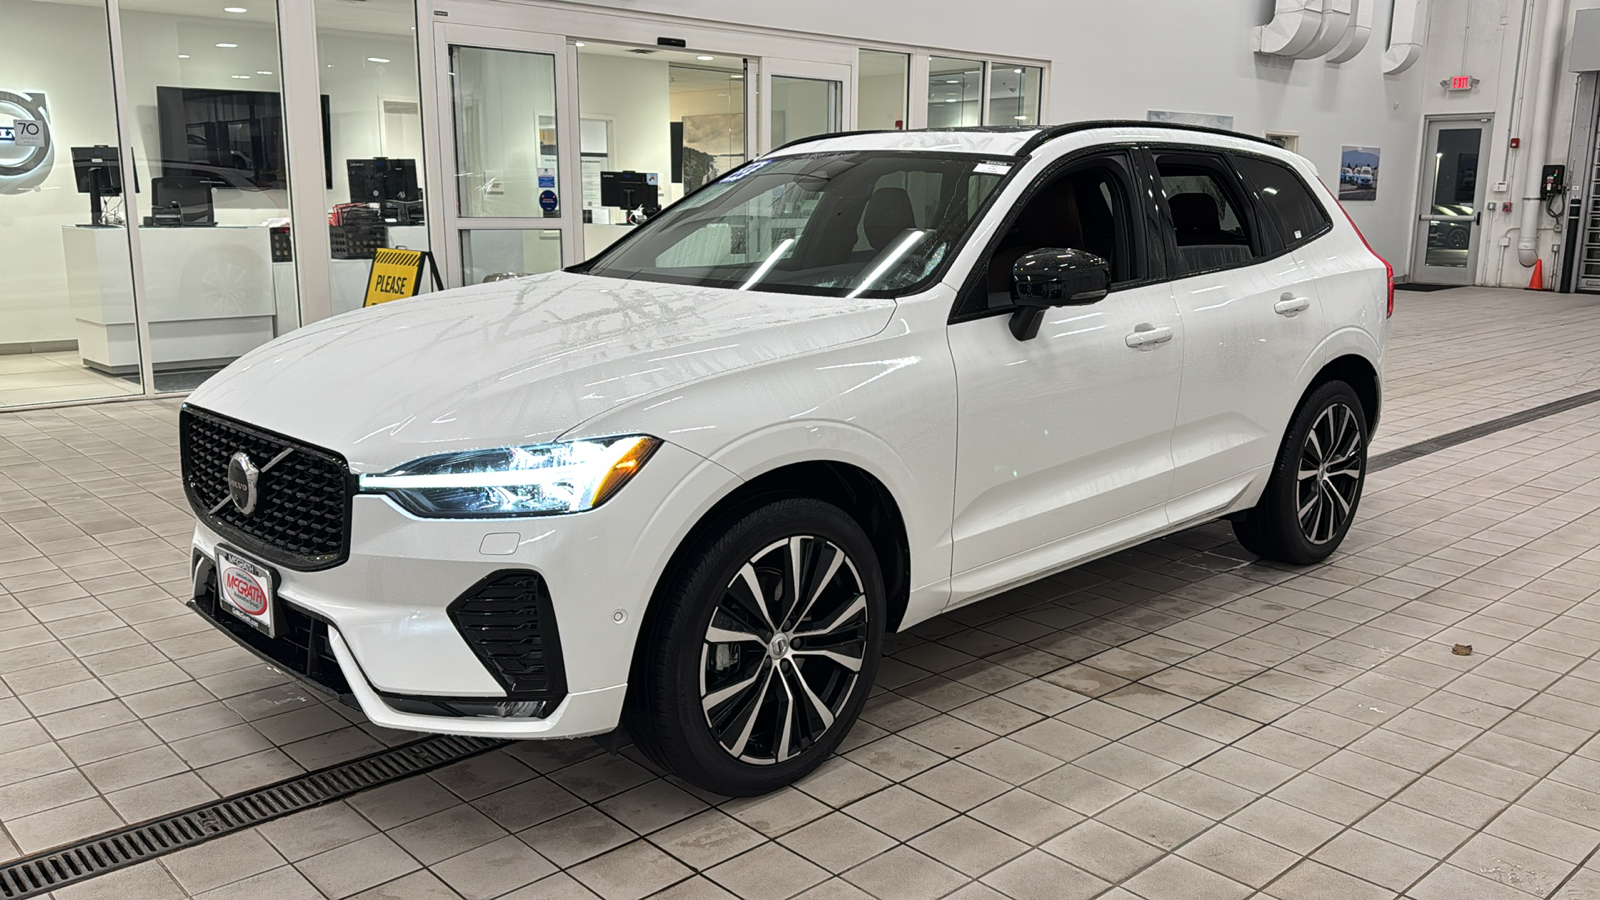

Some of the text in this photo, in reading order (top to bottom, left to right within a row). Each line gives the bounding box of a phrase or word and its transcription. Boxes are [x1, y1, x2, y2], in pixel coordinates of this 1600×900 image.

[1452, 76, 1469, 89] EXIT
[17, 122, 40, 136] 70
[375, 274, 407, 295] PLEASE
[226, 573, 263, 604] McGRATH
